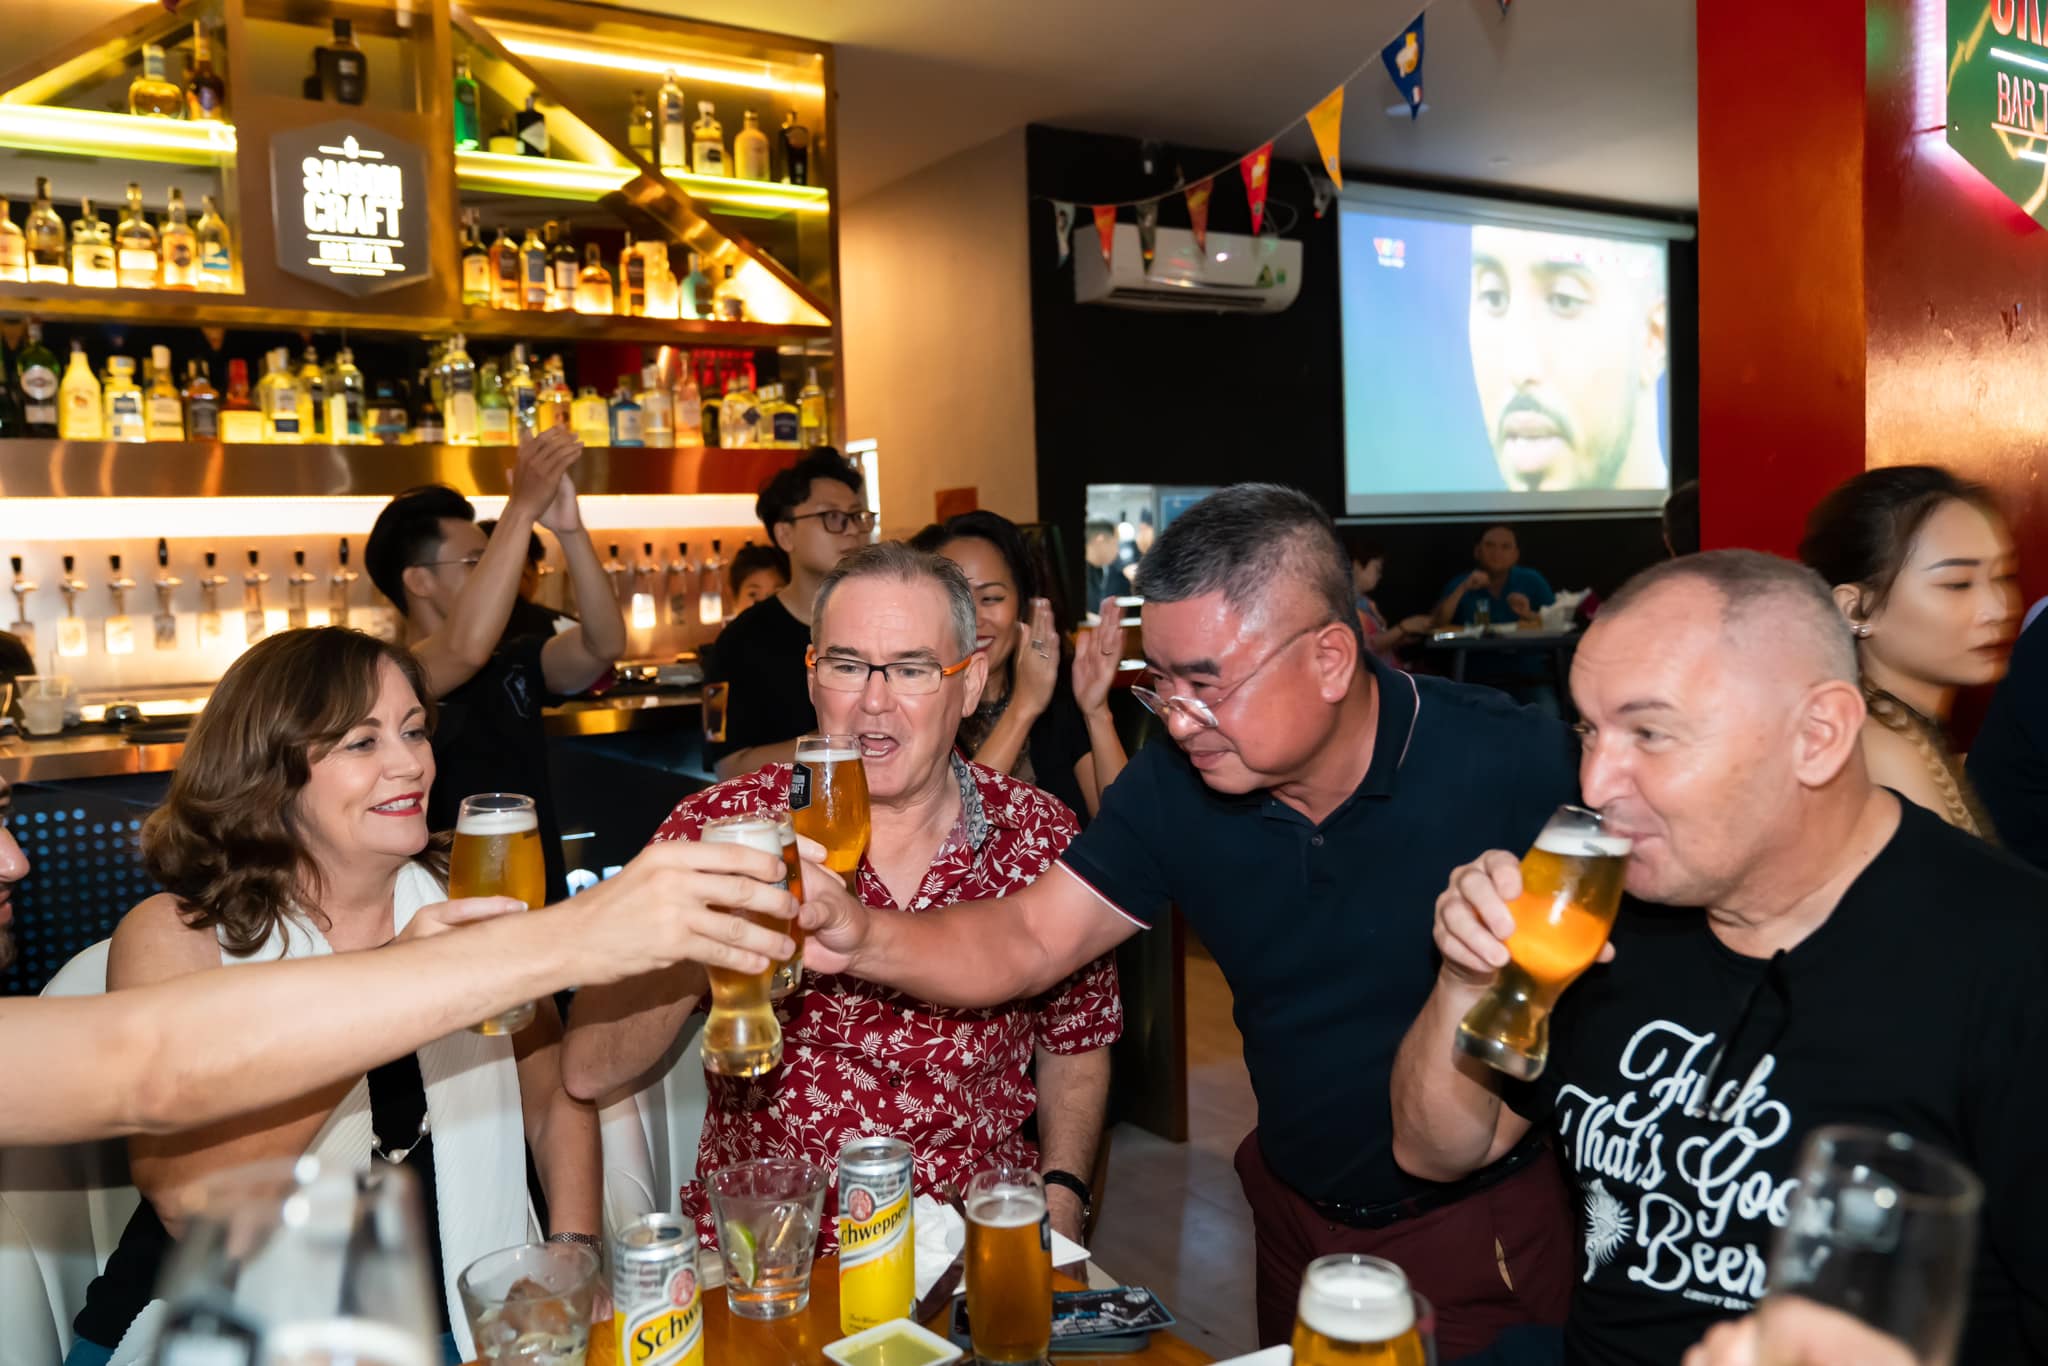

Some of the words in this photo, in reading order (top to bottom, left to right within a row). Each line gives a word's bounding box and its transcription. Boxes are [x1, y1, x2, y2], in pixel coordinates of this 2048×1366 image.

[1997, 71, 2035, 131] BAR
[303, 193, 404, 238] CRAFT
[790, 784, 804, 795] RAFT
[1615, 1019, 1791, 1148] Fuck
[1555, 1084, 1667, 1190] That's
[1676, 1126, 1802, 1238] Goo
[1628, 1193, 1770, 1298] Beer
